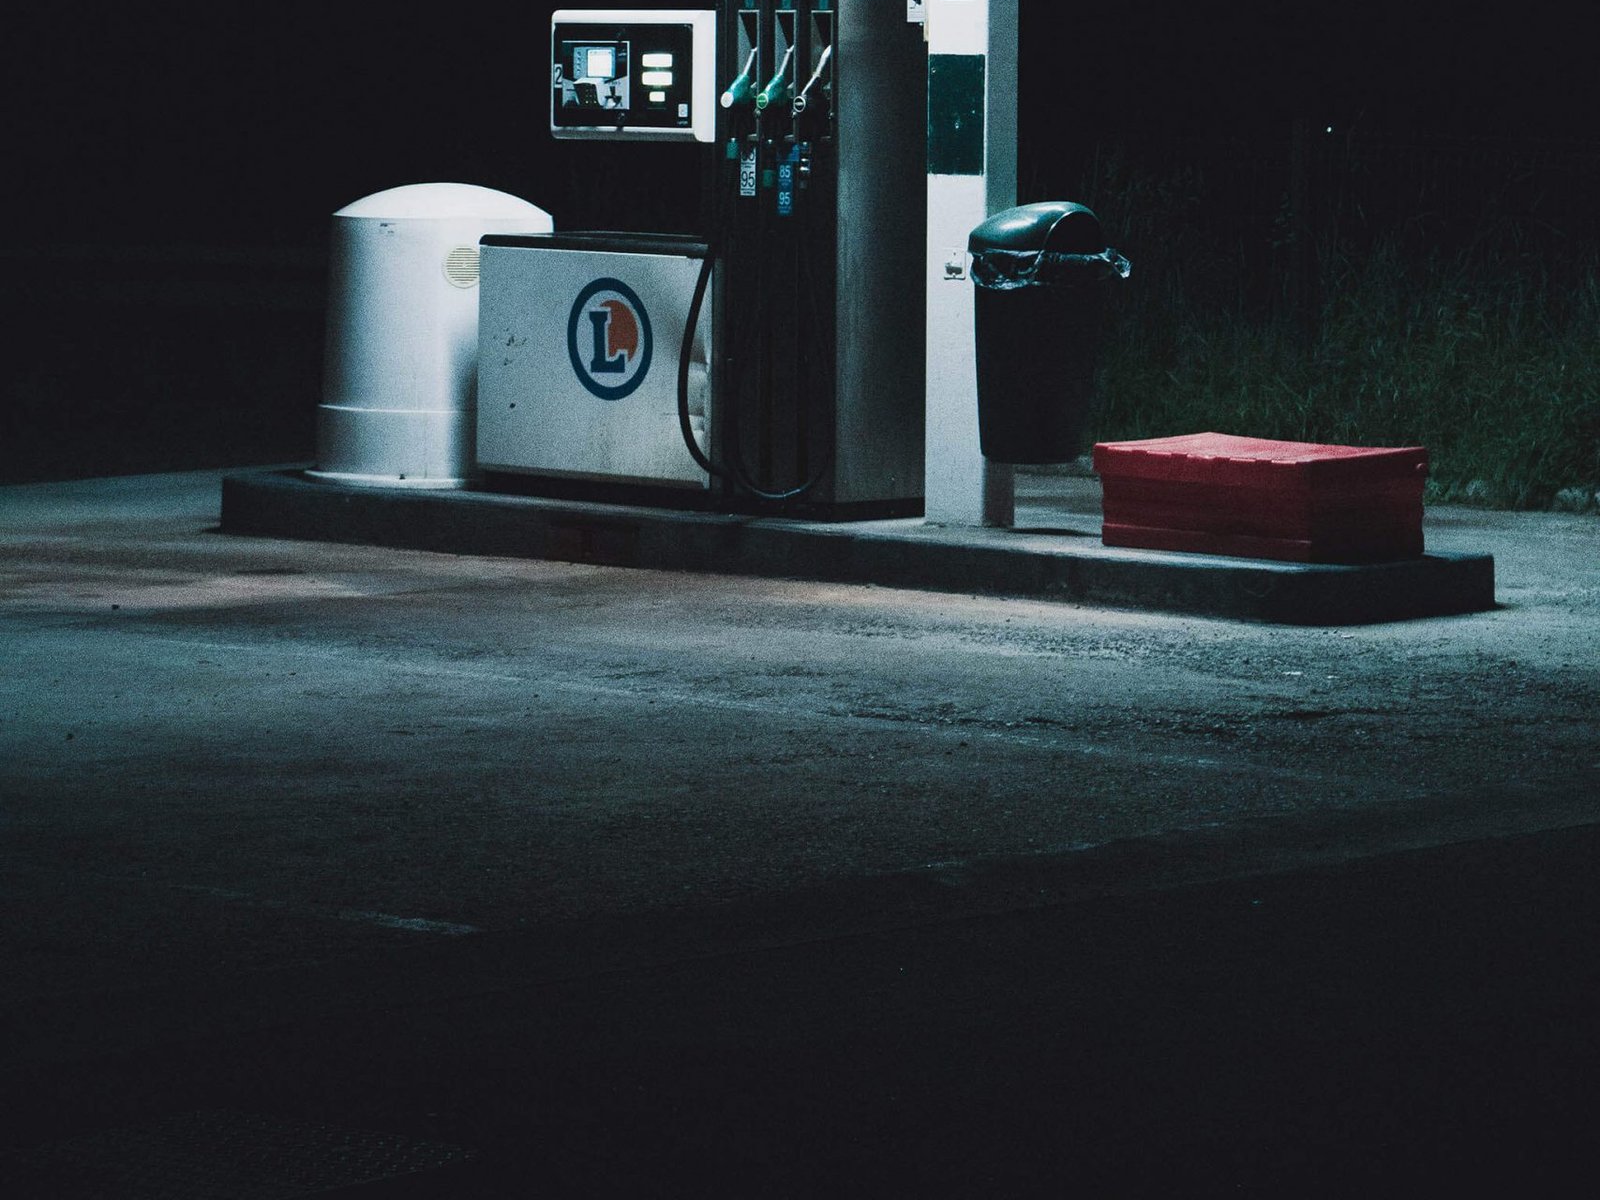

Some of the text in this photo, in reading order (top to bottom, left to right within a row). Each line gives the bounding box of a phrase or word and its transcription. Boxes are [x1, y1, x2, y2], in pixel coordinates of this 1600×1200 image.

[555, 66, 562, 84] 2
[741, 170, 755, 187] 95
[779, 166, 790, 177] 85
[779, 192, 790, 204] 95
[589, 311, 625, 373] L
